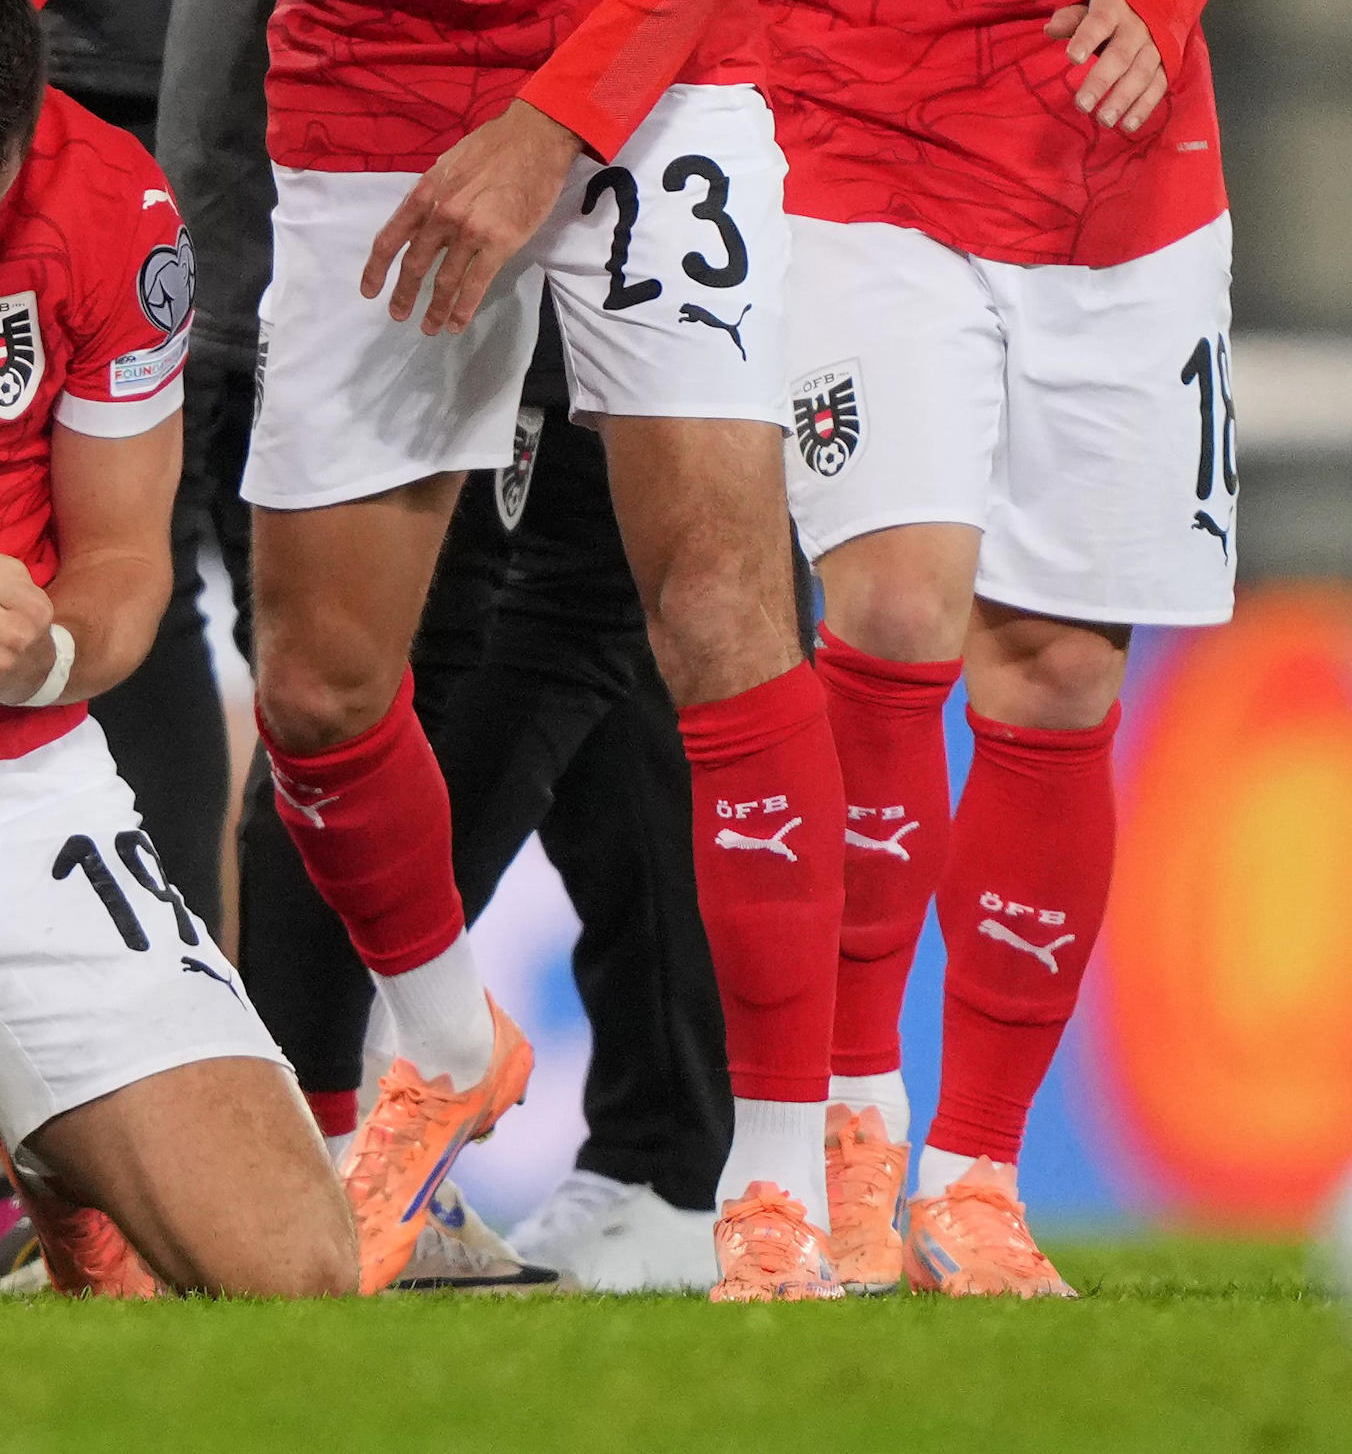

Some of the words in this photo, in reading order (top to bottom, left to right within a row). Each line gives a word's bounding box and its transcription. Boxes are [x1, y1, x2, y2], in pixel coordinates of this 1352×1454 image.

[581, 154, 749, 310] 23
[716, 794, 789, 819] ÖFB
[847, 804, 905, 821] FB
[52, 830, 199, 952] 19
[979, 890, 1066, 926] ÖFB
